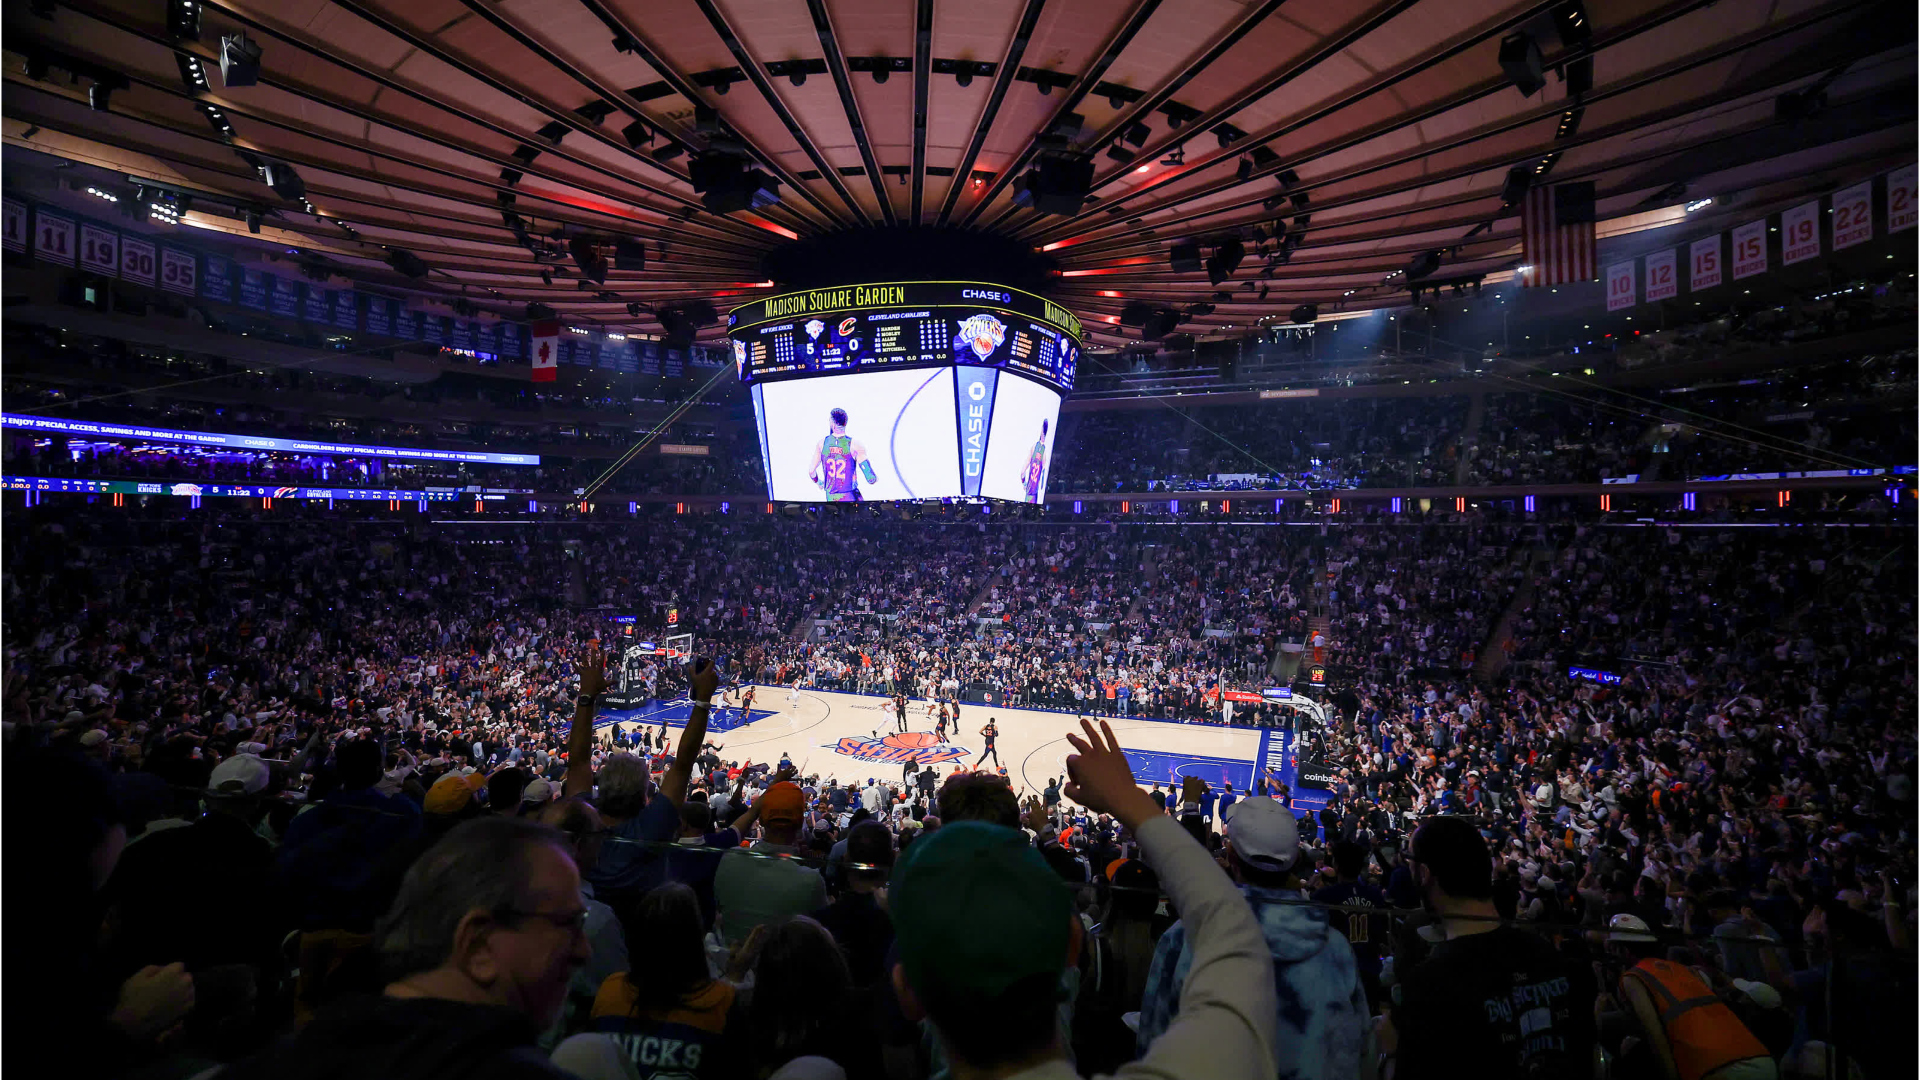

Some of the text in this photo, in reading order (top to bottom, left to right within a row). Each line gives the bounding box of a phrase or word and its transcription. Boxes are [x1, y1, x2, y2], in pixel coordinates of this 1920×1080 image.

[1835, 201, 1868, 231] 22
[42, 227, 67, 254] 11
[1788, 220, 1813, 247] 19
[87, 239, 113, 265] 19
[1738, 237, 1761, 262] 15
[125, 250, 152, 275] 30
[164, 261, 193, 286] 35
[1696, 251, 1715, 275] 15
[1612, 275, 1630, 296] 10
[1651, 265, 1671, 286] 12
[765, 286, 904, 318] MADISON SQUARE GARDEN
[962, 289, 1001, 301] CHASE
[868, 311, 930, 321] CLEVELAND CAVALIERS
[807, 343, 815, 355] 5
[849, 339, 859, 351] 0
[8, 418, 35, 426] ENJOY
[36, 420, 68, 429] SPECIAL
[69, 424, 99, 433] ACCESS,
[100, 426, 133, 435] SAVINGS
[198, 435, 226, 443] GARDEN
[966, 404, 983, 477] CHASE
[293, 443, 335, 451] CARDHOLDERS
[335, 445, 353, 453] ENJOY
[826, 458, 846, 479] 32
[1031, 462, 1040, 483] 32
[258, 487, 264, 495] 0
[668, 613, 677, 623] 23
[1348, 913, 1369, 943] 11
